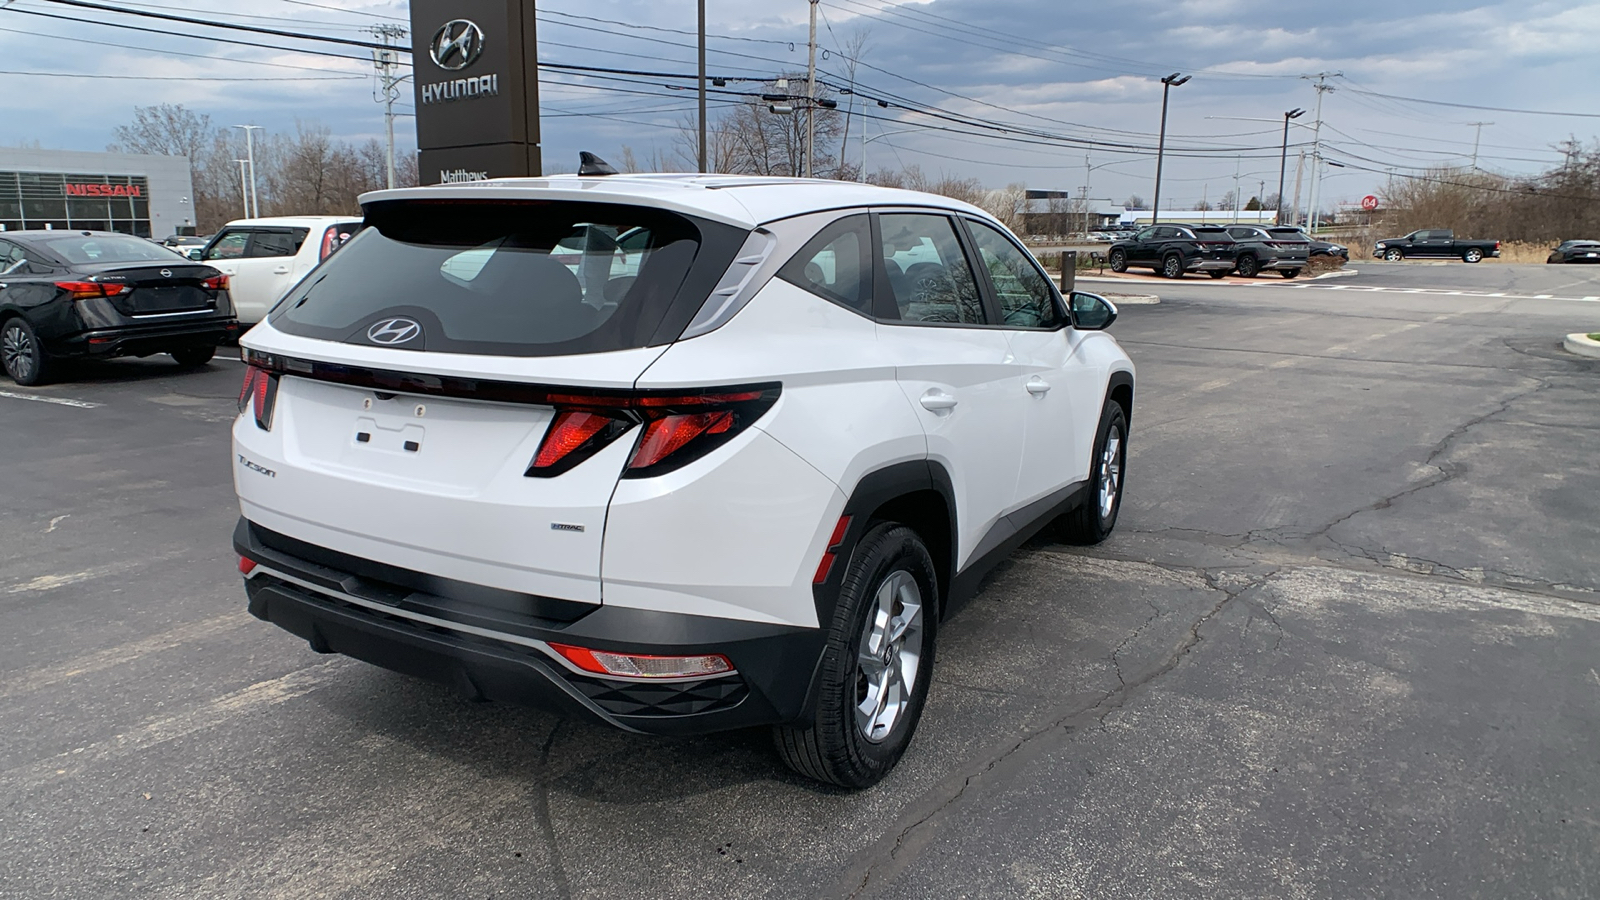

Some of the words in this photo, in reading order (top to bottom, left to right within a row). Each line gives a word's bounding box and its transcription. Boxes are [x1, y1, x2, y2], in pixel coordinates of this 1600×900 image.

[421, 74, 498, 104] HYUNDAI
[440, 168, 488, 184] Matthews
[66, 183, 140, 197] NISSAN
